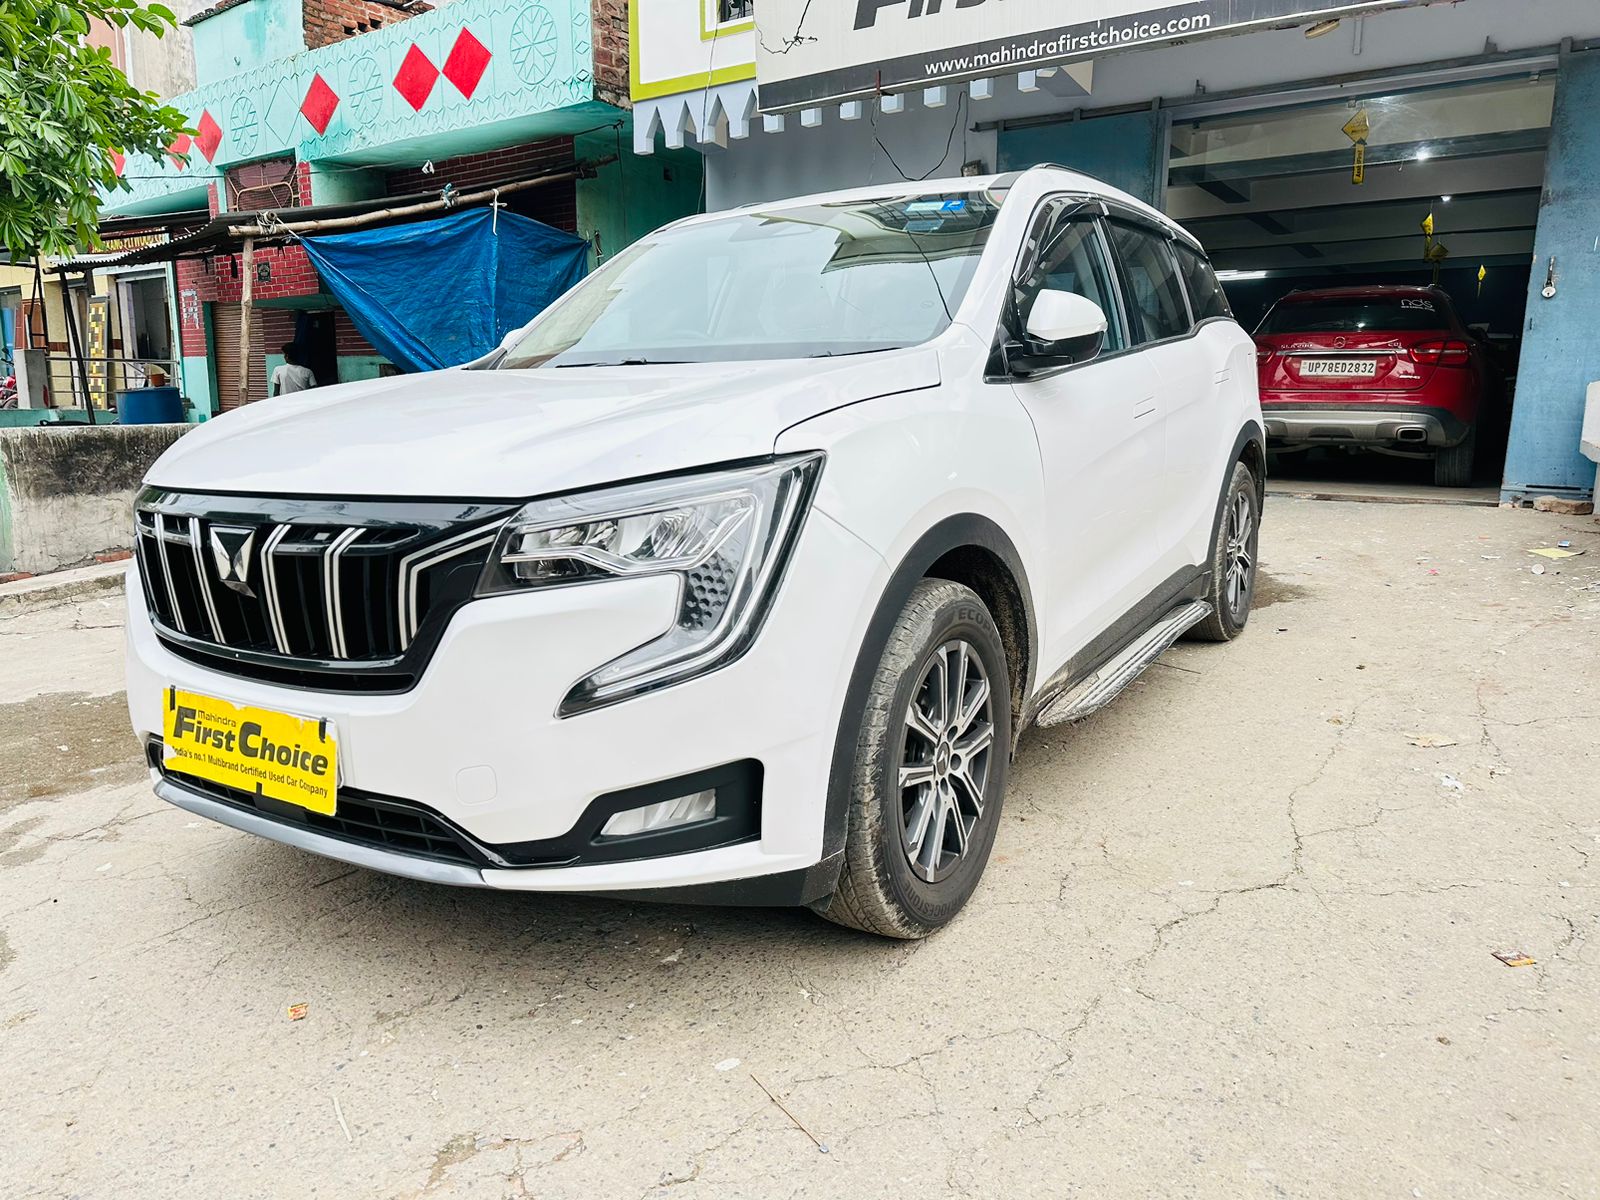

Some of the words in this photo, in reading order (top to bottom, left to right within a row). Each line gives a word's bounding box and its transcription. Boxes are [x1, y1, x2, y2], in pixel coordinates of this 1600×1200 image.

[924, 11, 1211, 75] www.mahindrafirstchoice.com
[1308, 362, 1375, 373] UP78ED2832
[173, 705, 236, 752] First
[239, 721, 329, 776] Choice
[208, 753, 239, 772] Multibrand
[240, 763, 267, 779] Certified
[268, 770, 285, 784] Used
[286, 775, 298, 787] Car
[299, 778, 328, 799] Company
